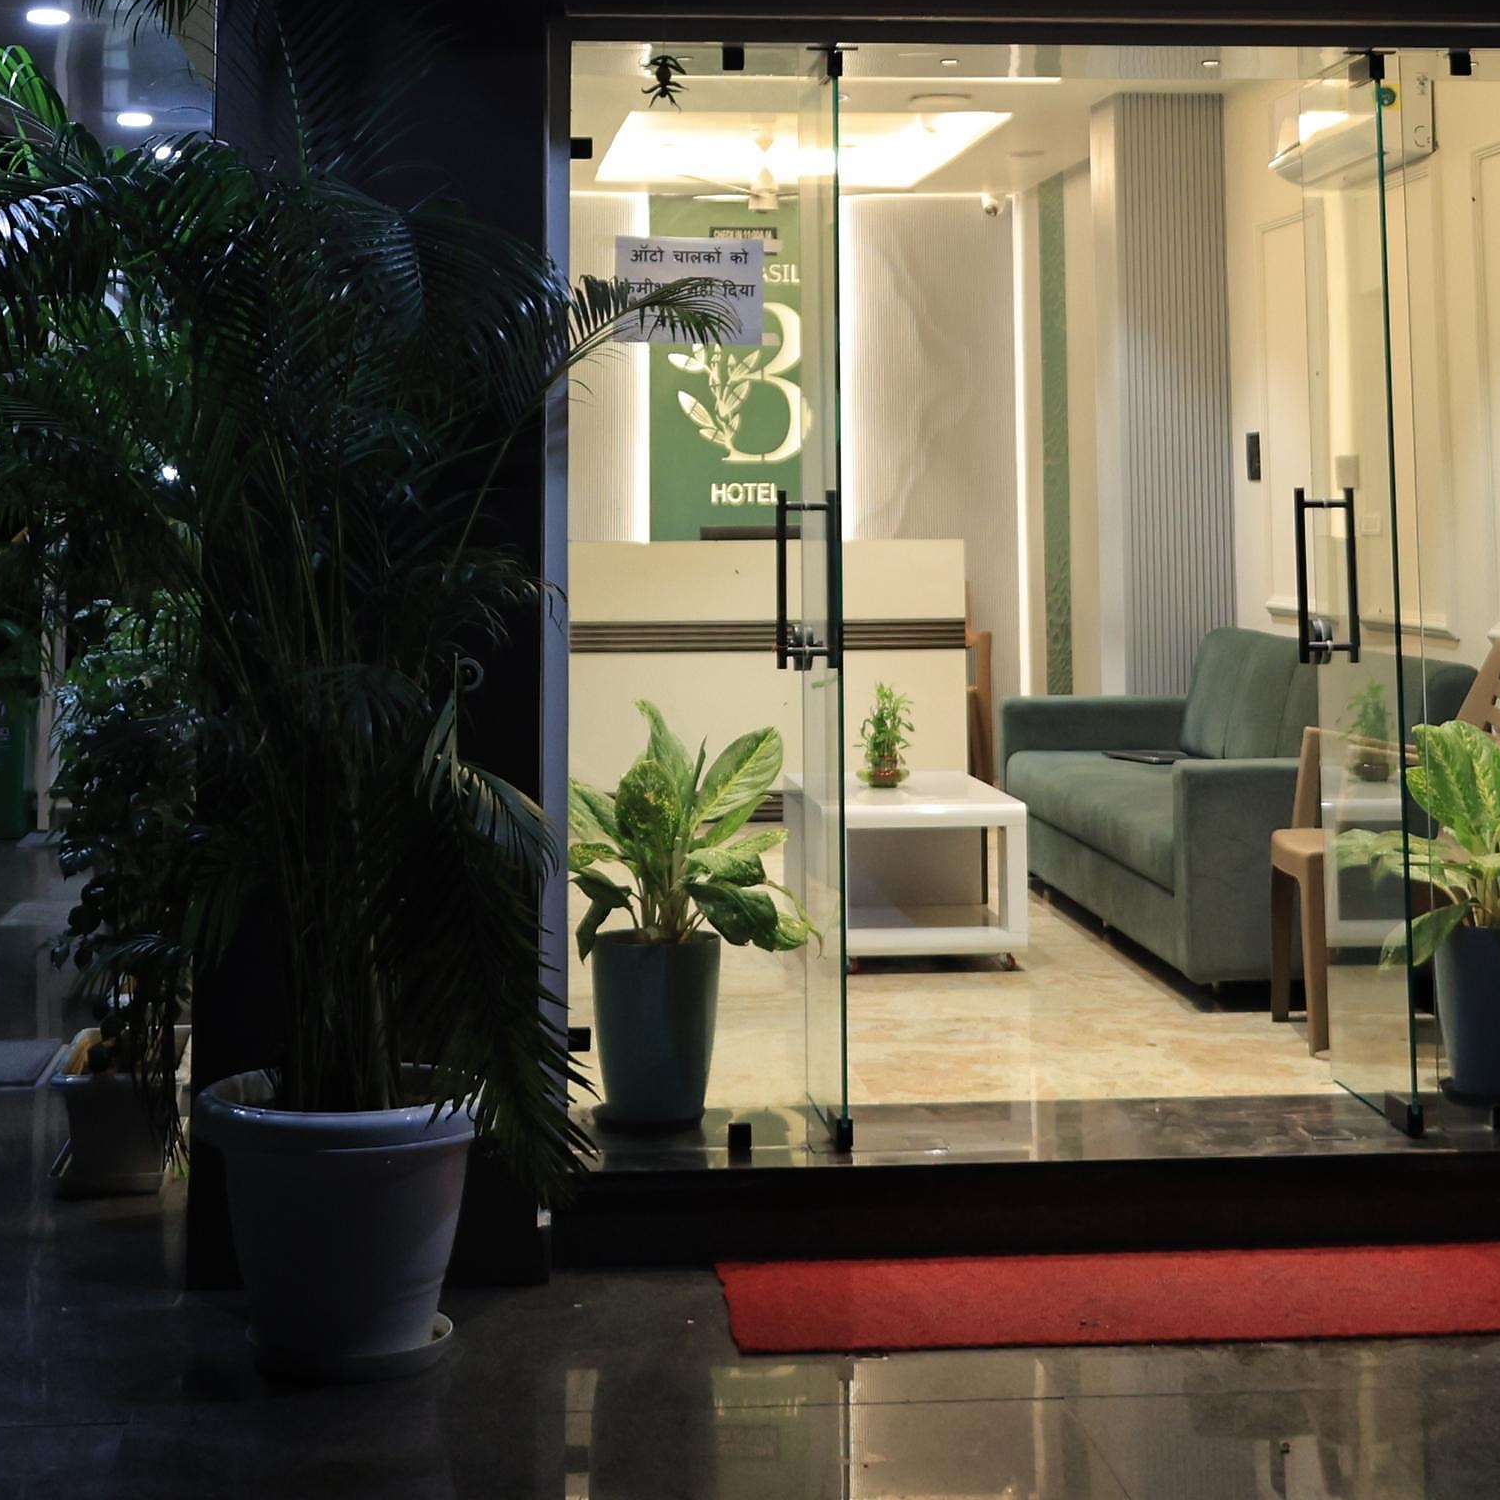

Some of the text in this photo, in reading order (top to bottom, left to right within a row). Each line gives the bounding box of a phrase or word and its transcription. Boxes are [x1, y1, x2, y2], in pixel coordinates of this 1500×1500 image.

[630, 243, 749, 264] ऑटो चालकों को
[723, 279, 756, 299] दिया
[711, 482, 779, 505] HOTEL
